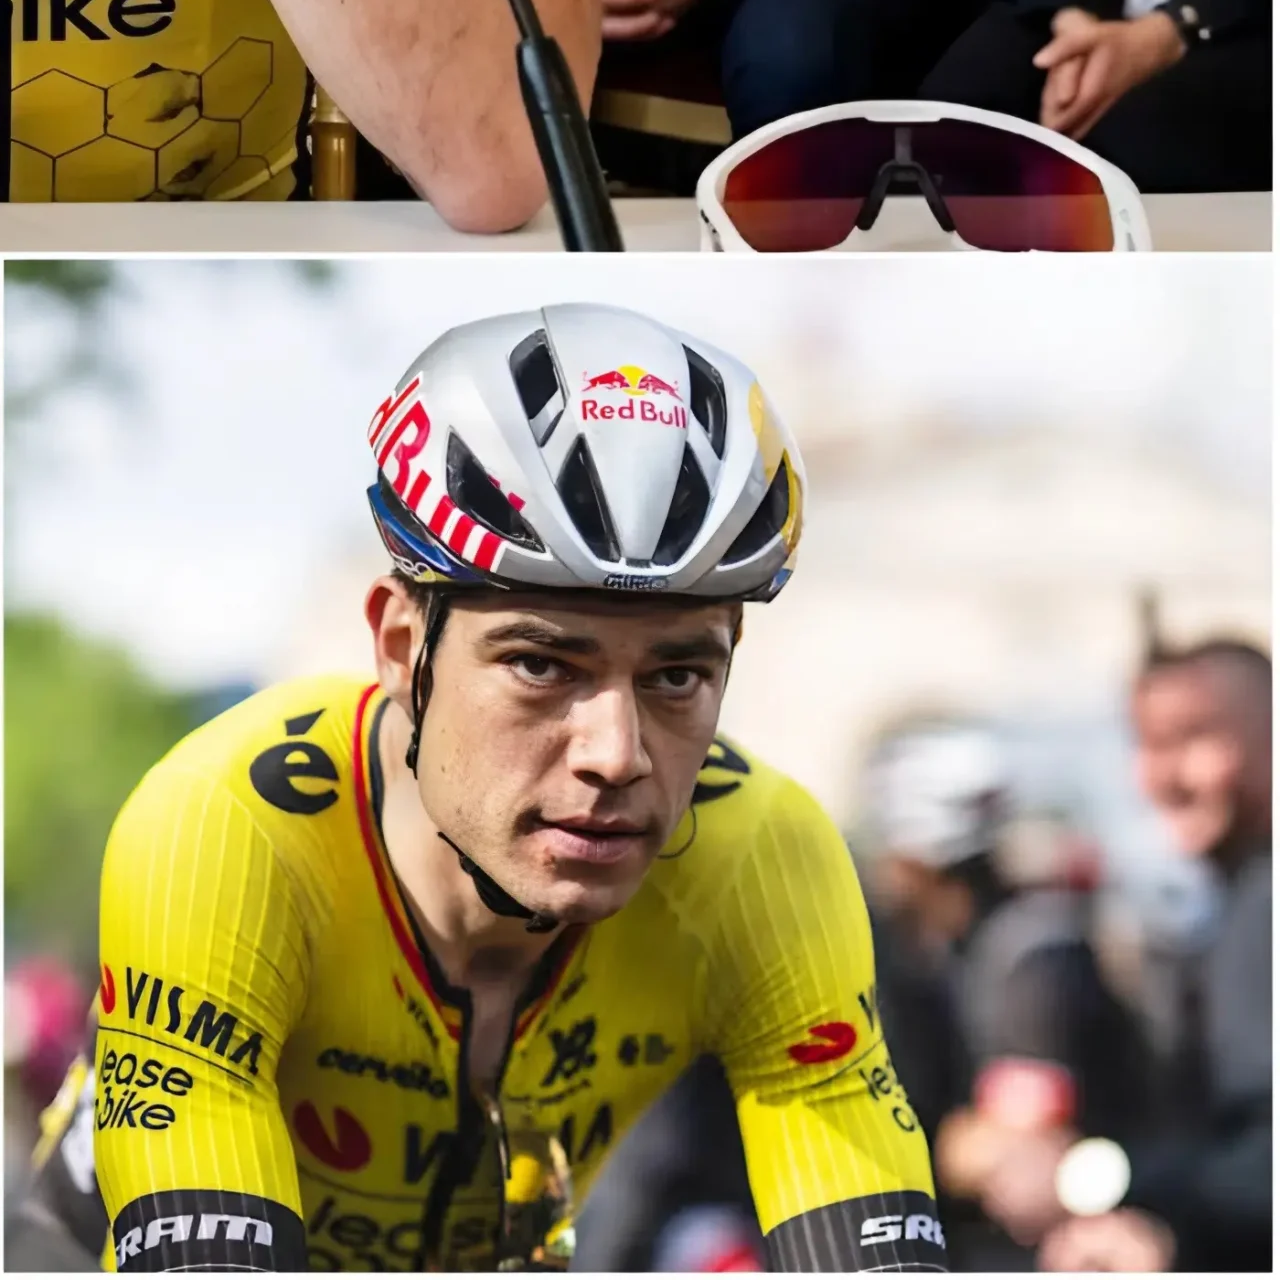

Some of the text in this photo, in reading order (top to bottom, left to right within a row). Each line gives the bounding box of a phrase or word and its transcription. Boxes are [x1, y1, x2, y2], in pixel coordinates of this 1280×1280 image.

[581, 398, 687, 429] Red Bull
[126, 966, 264, 1076] VISMA
